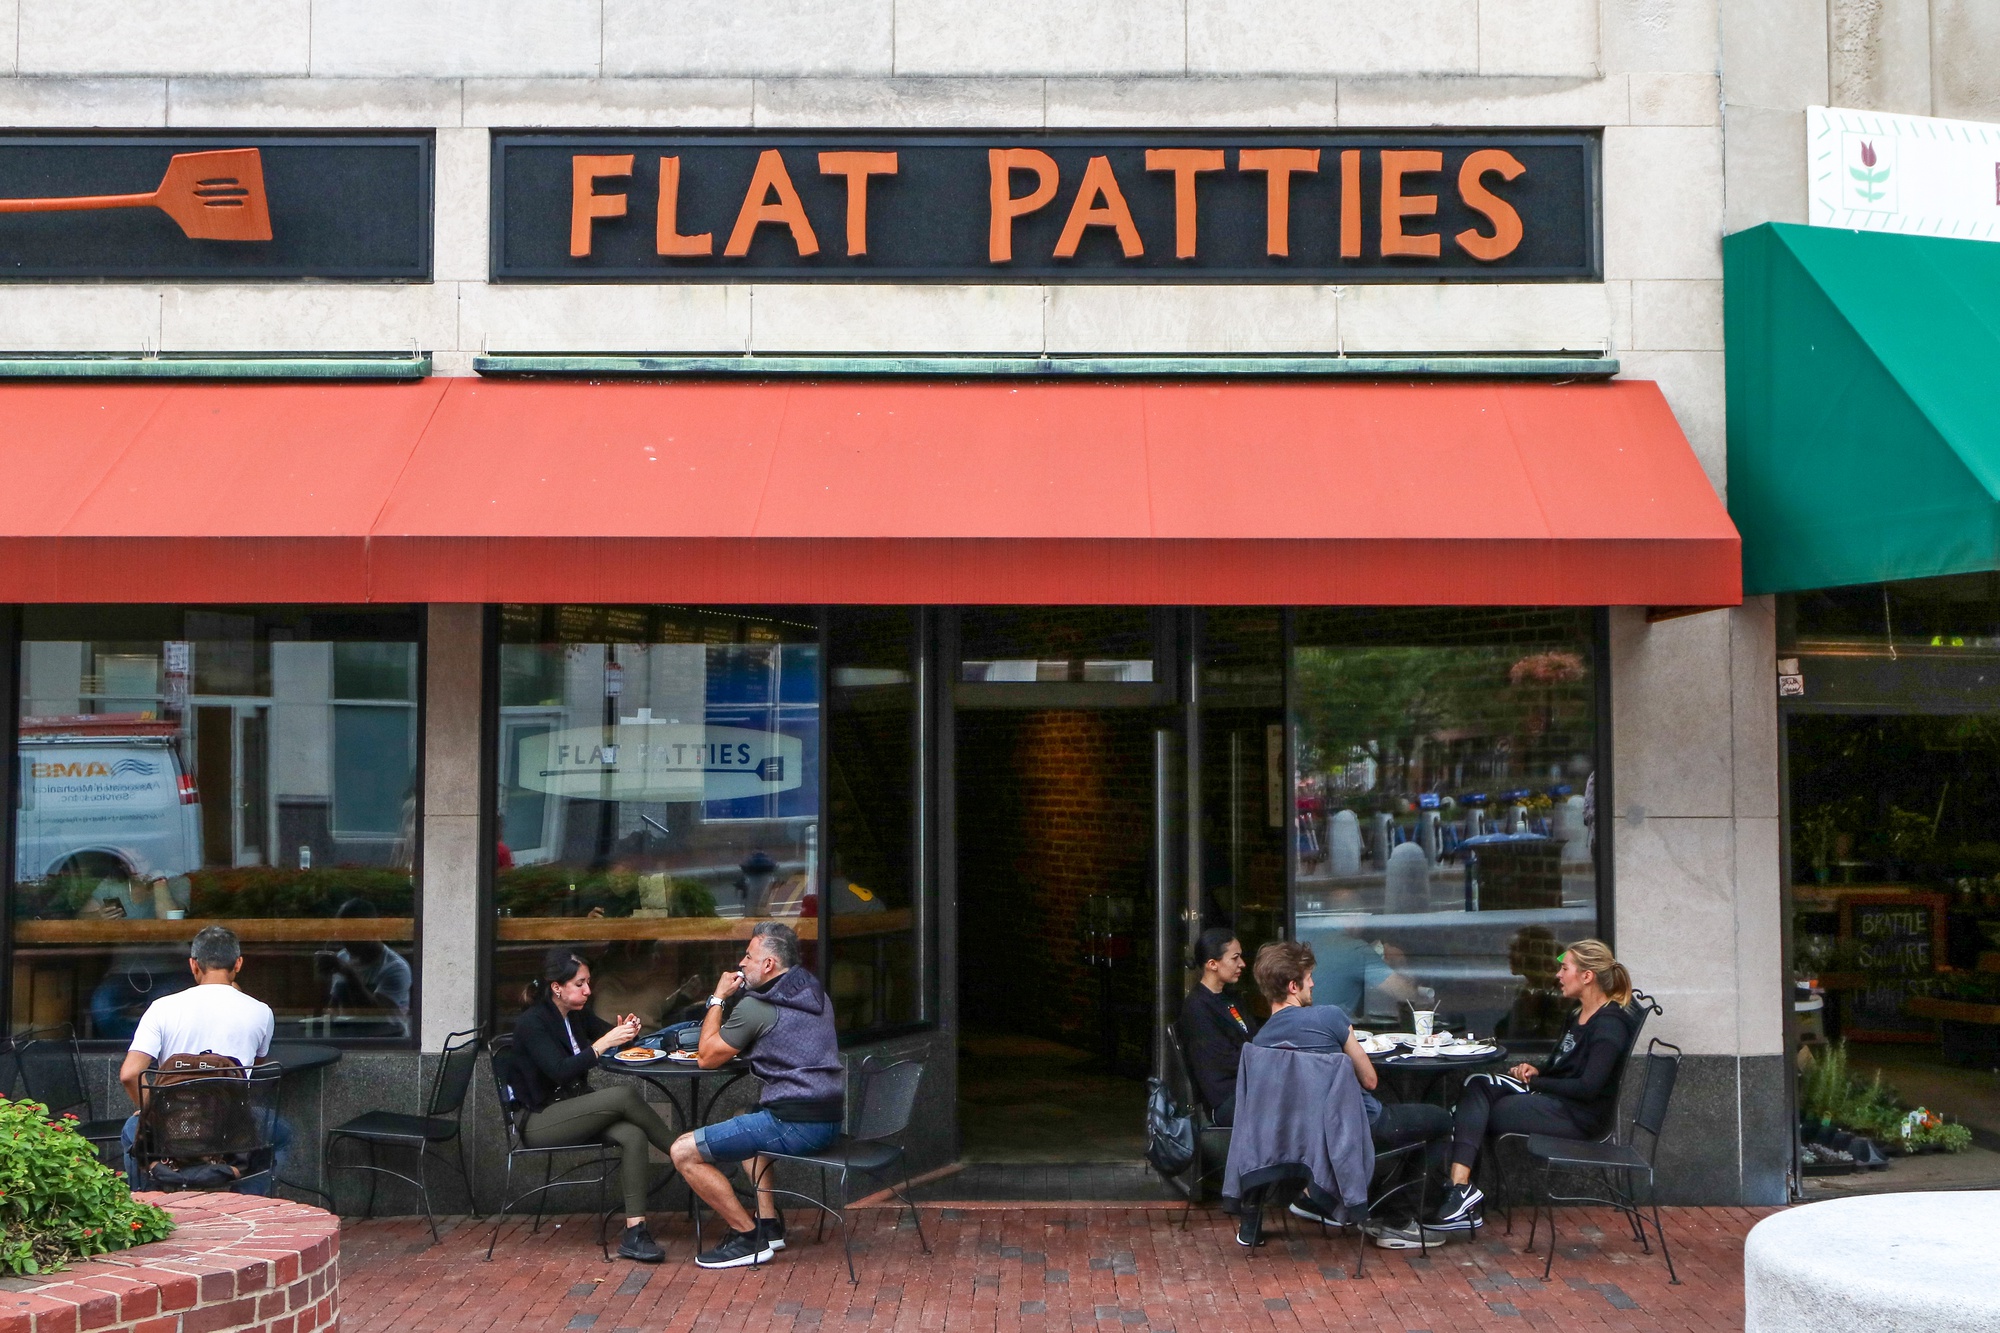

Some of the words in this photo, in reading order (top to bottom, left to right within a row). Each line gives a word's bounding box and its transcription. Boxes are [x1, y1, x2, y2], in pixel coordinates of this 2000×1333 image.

[569, 149, 899, 258] FLAT
[988, 147, 1527, 263] PATTIES
[558, 744, 620, 765] FLAT
[637, 743, 750, 765] PATTIES
[1862, 912, 1927, 936] BRATTLE
